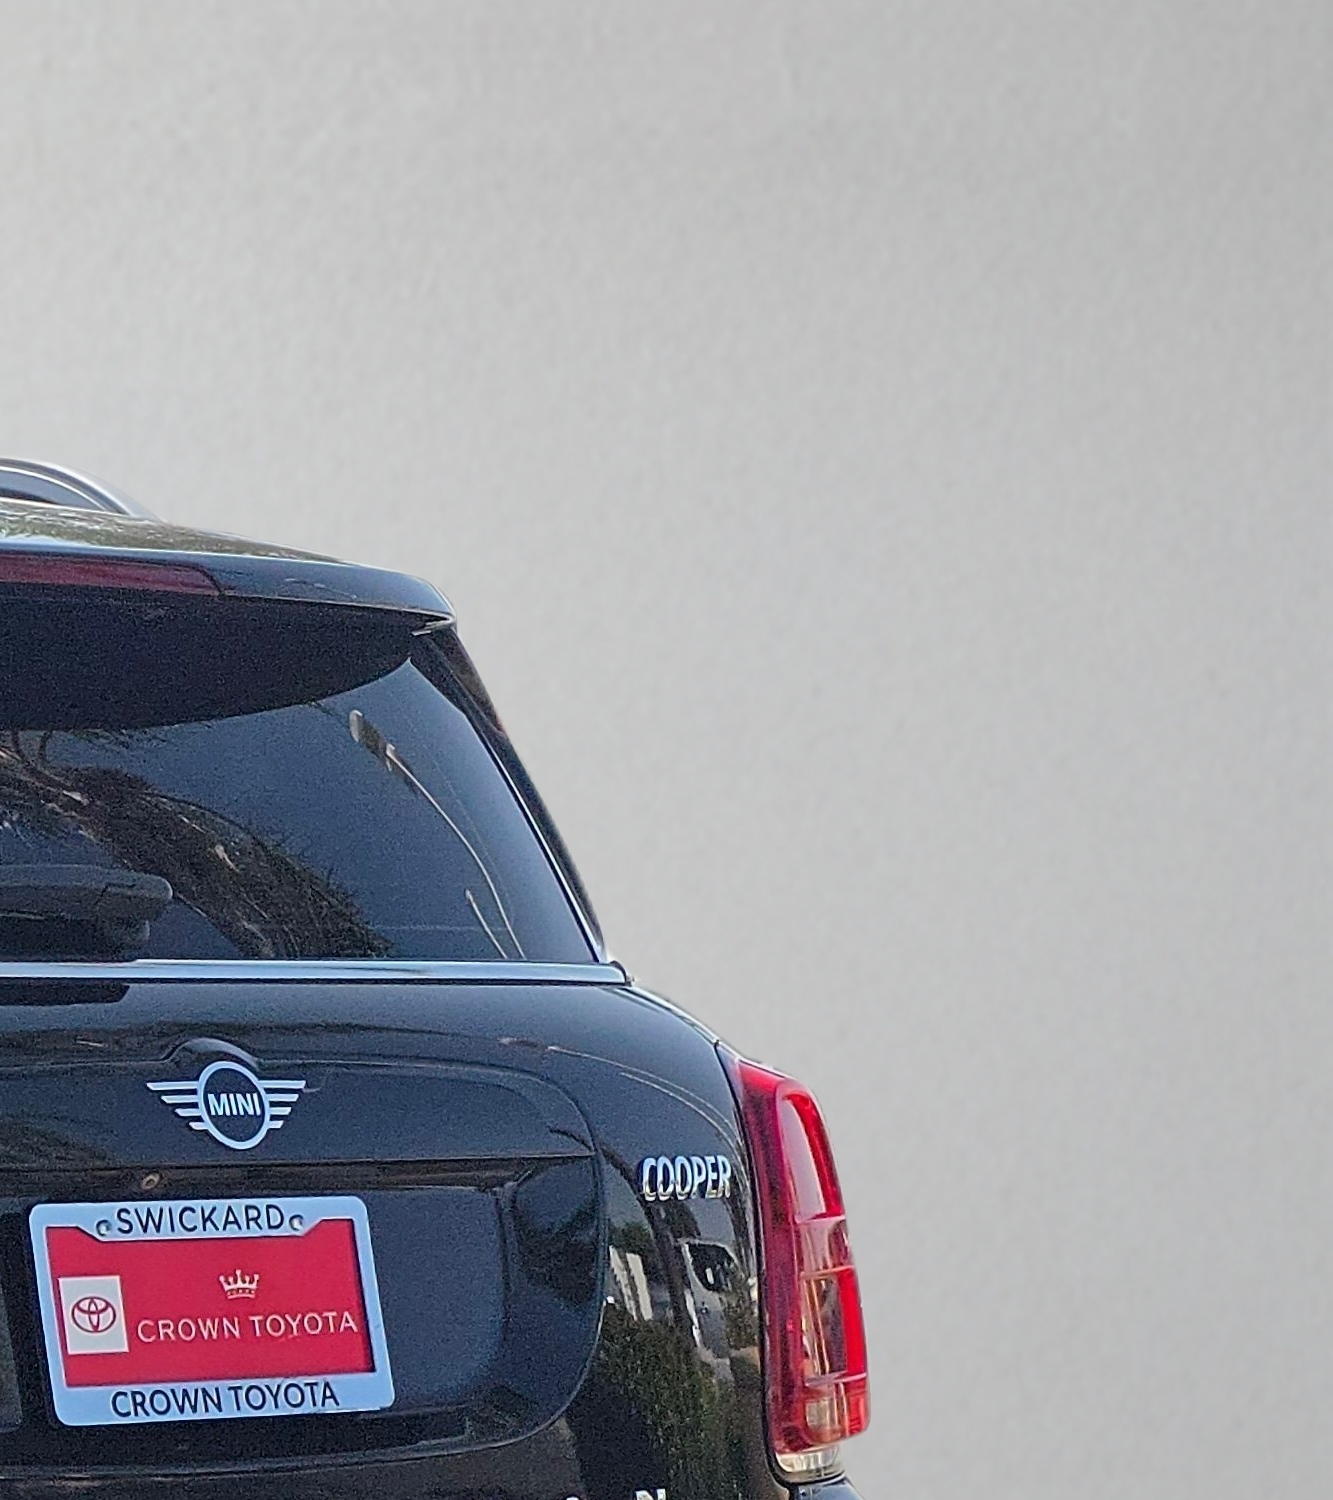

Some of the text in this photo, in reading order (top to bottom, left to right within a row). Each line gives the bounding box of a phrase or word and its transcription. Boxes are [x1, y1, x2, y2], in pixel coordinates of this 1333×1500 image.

[207, 1093, 262, 1116] MINI
[642, 1154, 732, 1202] COOPER
[116, 1204, 286, 1234] SWICKARD
[137, 1311, 358, 1343] CROWN TOYOTA
[111, 1381, 340, 1418] CROWN TOYOTA
